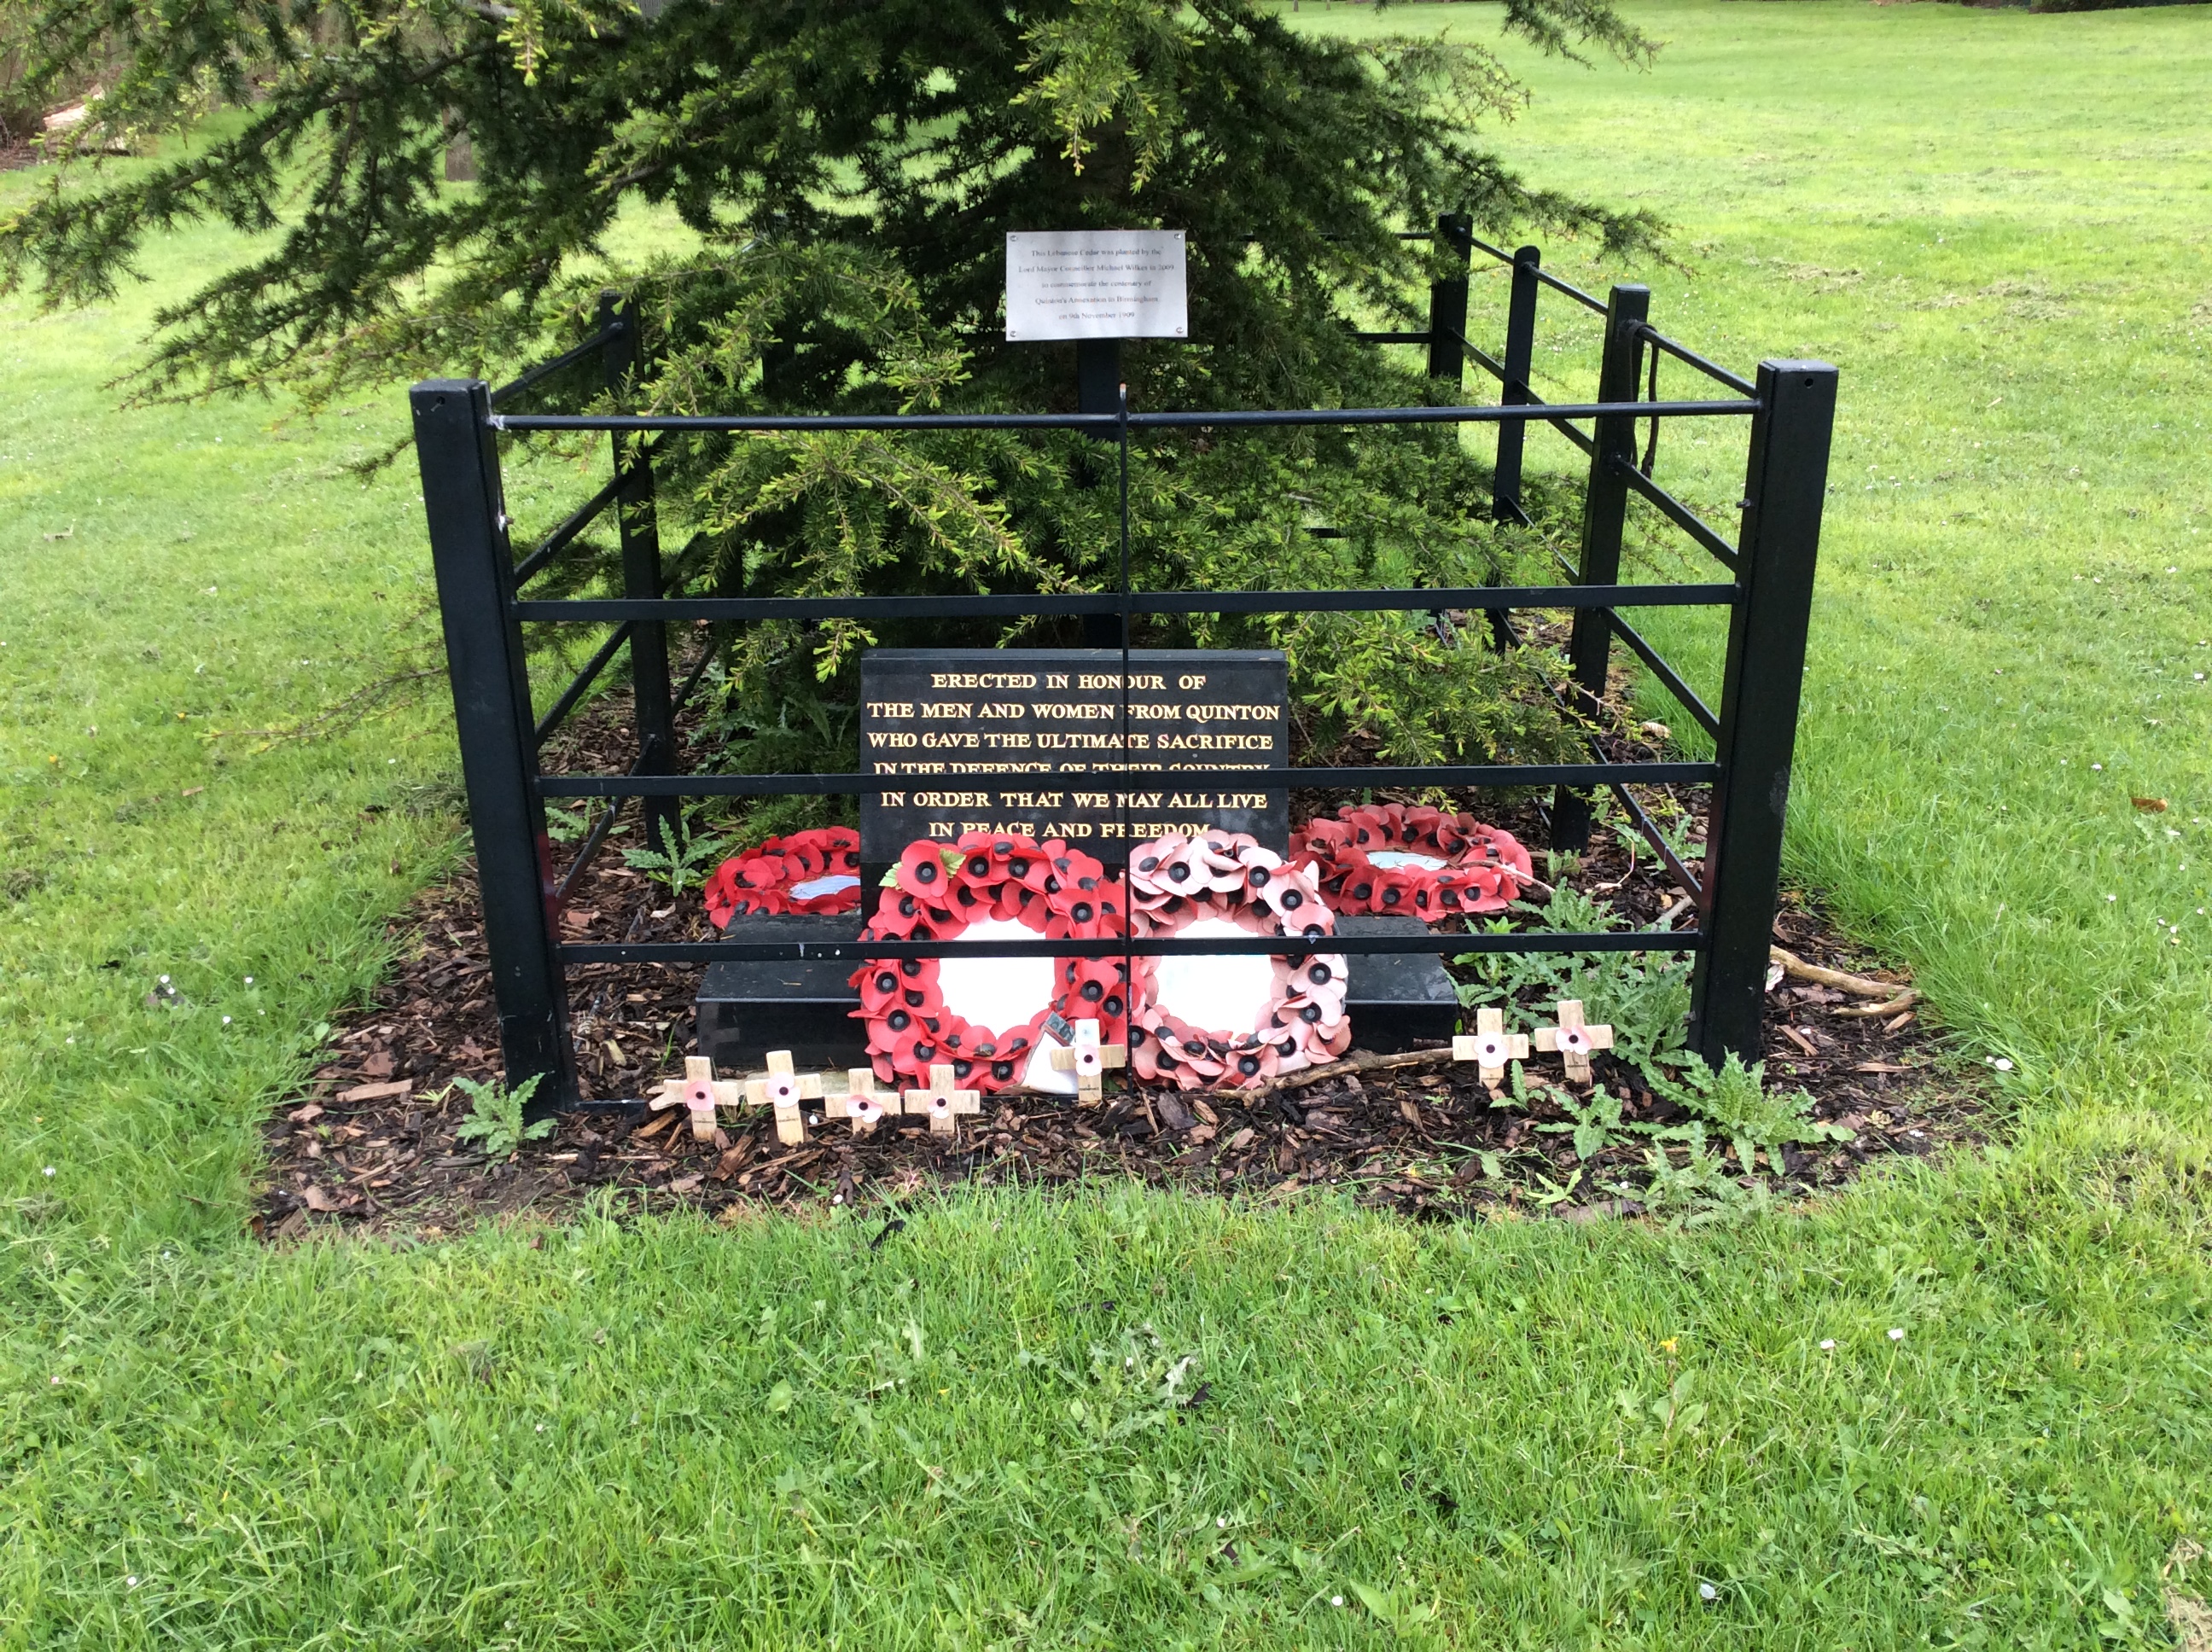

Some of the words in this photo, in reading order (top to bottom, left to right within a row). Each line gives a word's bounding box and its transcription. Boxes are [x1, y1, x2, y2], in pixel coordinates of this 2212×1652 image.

[1115, 248, 1140, 258] planted
[1141, 248, 1150, 257] by
[1018, 265, 1035, 273] Lord
[1036, 265, 1058, 274] Mayor
[1096, 264, 1124, 272] Michael
[1110, 280, 1142, 288] centenary
[1035, 297, 1068, 305] Quinton's
[1116, 295, 1159, 305] Birmingham
[930, 672, 1037, 689] ERECTED
[1045, 673, 1070, 689] IN
[1078, 673, 1167, 690] HONOUR
[1178, 674, 1207, 690] OF
[866, 701, 916, 718] THE
[920, 702, 974, 718] MEN
[976, 702, 1026, 718] AND
[1031, 703, 1115, 720] WOMEN
[1120, 704, 1182, 720] FROM
[1185, 704, 1281, 724] QUINTON
[866, 731, 918, 748] WHO
[922, 731, 980, 748] GAVE
[983, 732, 1033, 748] THE
[1036, 732, 1150, 749] ULTIMATE
[1156, 733, 1274, 750] SACRIFICE
[873, 762, 898, 775] IN
[900, 762, 946, 775] THE
[949, 762, 1052, 773] DEFENCE
[881, 791, 906, 807] IN
[913, 791, 992, 807] ORDER
[999, 791, 1064, 808] THAT
[1071, 792, 1111, 808] WE
[1115, 793, 1164, 808] MAY
[1167, 793, 1214, 809] ALL
[1216, 793, 1268, 809] LIVE
[928, 822, 955, 837] IN
[960, 821, 1036, 837] PEACE
[1042, 822, 1092, 837] AND
[1099, 823, 1212, 838] FREEDOM
